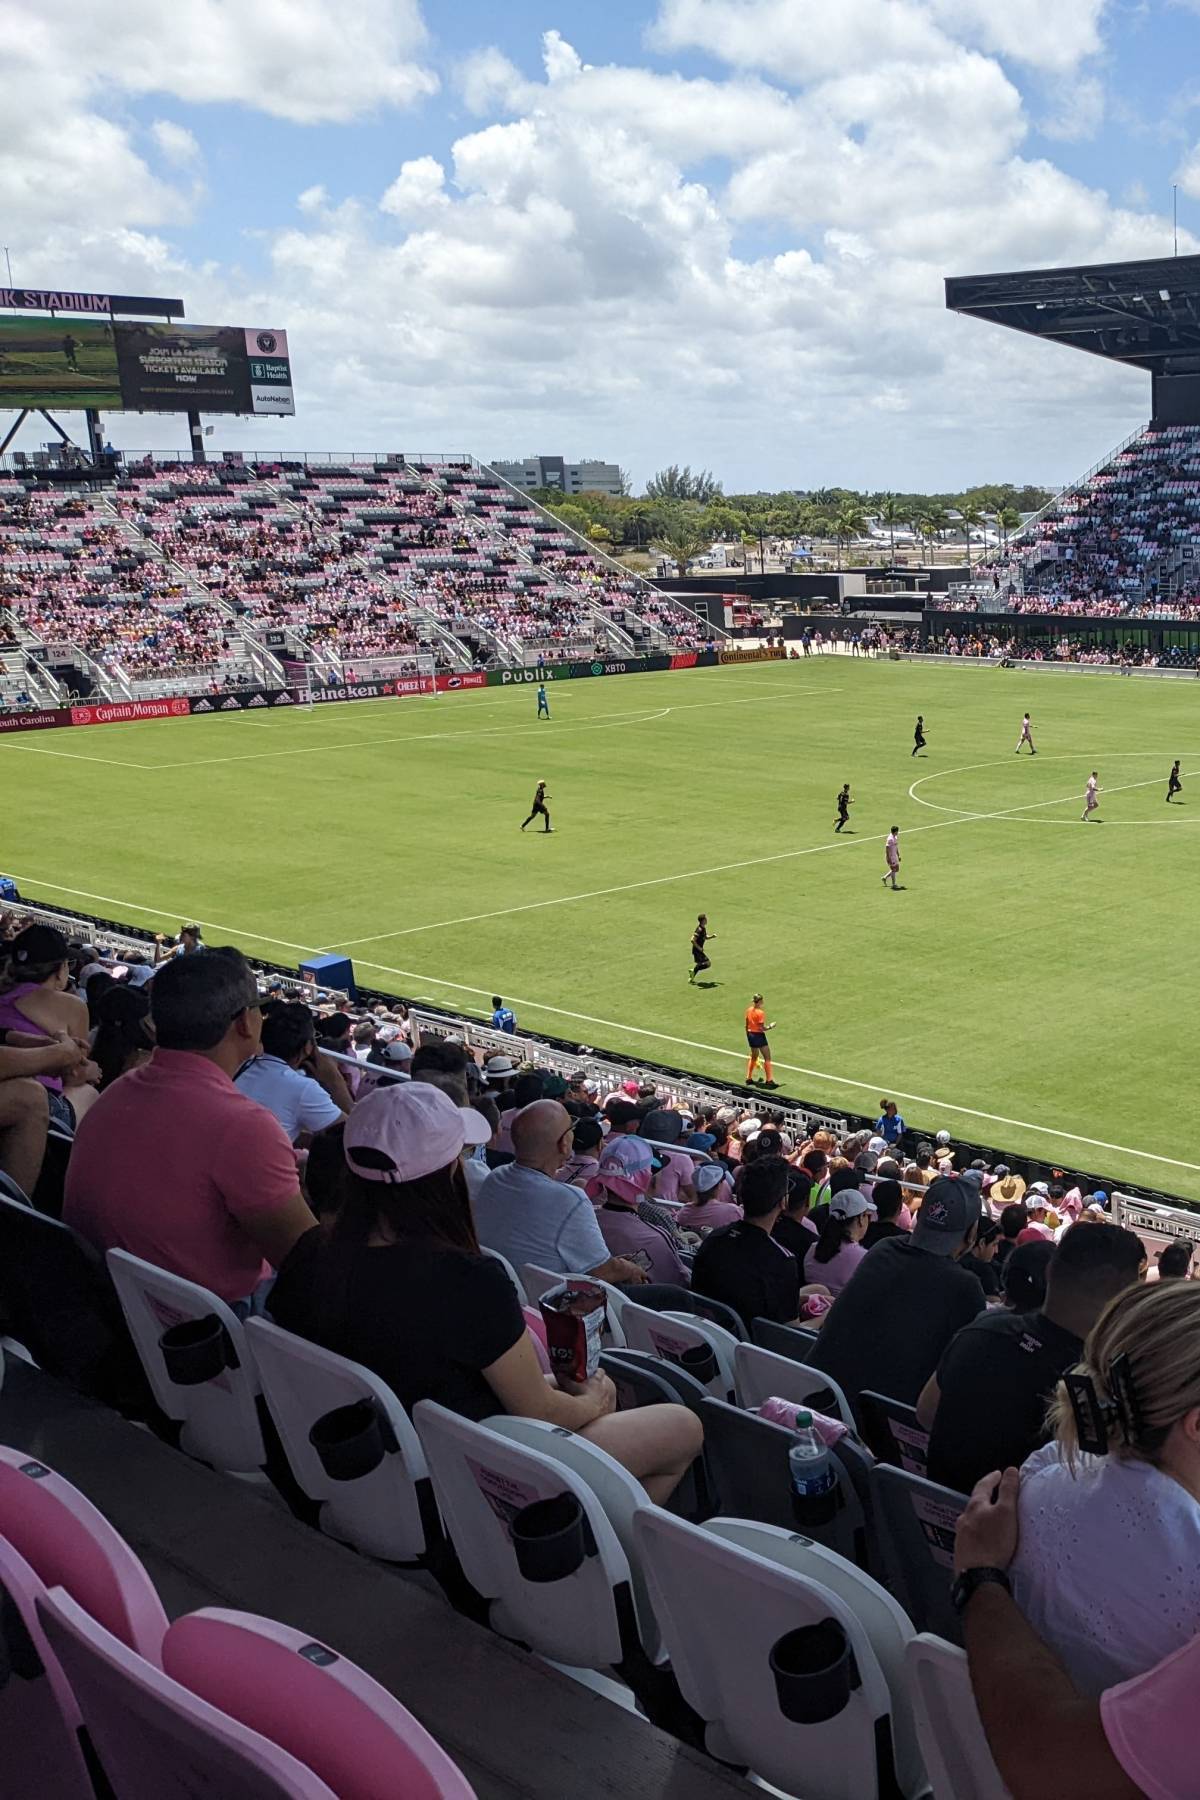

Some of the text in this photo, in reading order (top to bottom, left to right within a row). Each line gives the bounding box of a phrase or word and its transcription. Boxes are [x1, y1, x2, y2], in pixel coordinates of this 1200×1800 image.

[0, 290, 111, 312] K STADIUM
[144, 364, 225, 376] TICKETS AVAILABLE
[266, 364, 288, 373] Baptist
[266, 371, 288, 379] Health
[256, 395, 291, 403] AutoNation
[53, 650, 67, 658] 124
[721, 650, 762, 664] Continental
[604, 663, 626, 673] XBTO
[502, 668, 553, 684] Publix
[298, 684, 378, 703] Heineken
[95, 702, 169, 721] Captain Morgan
[20, 714, 56, 726] Carolina
